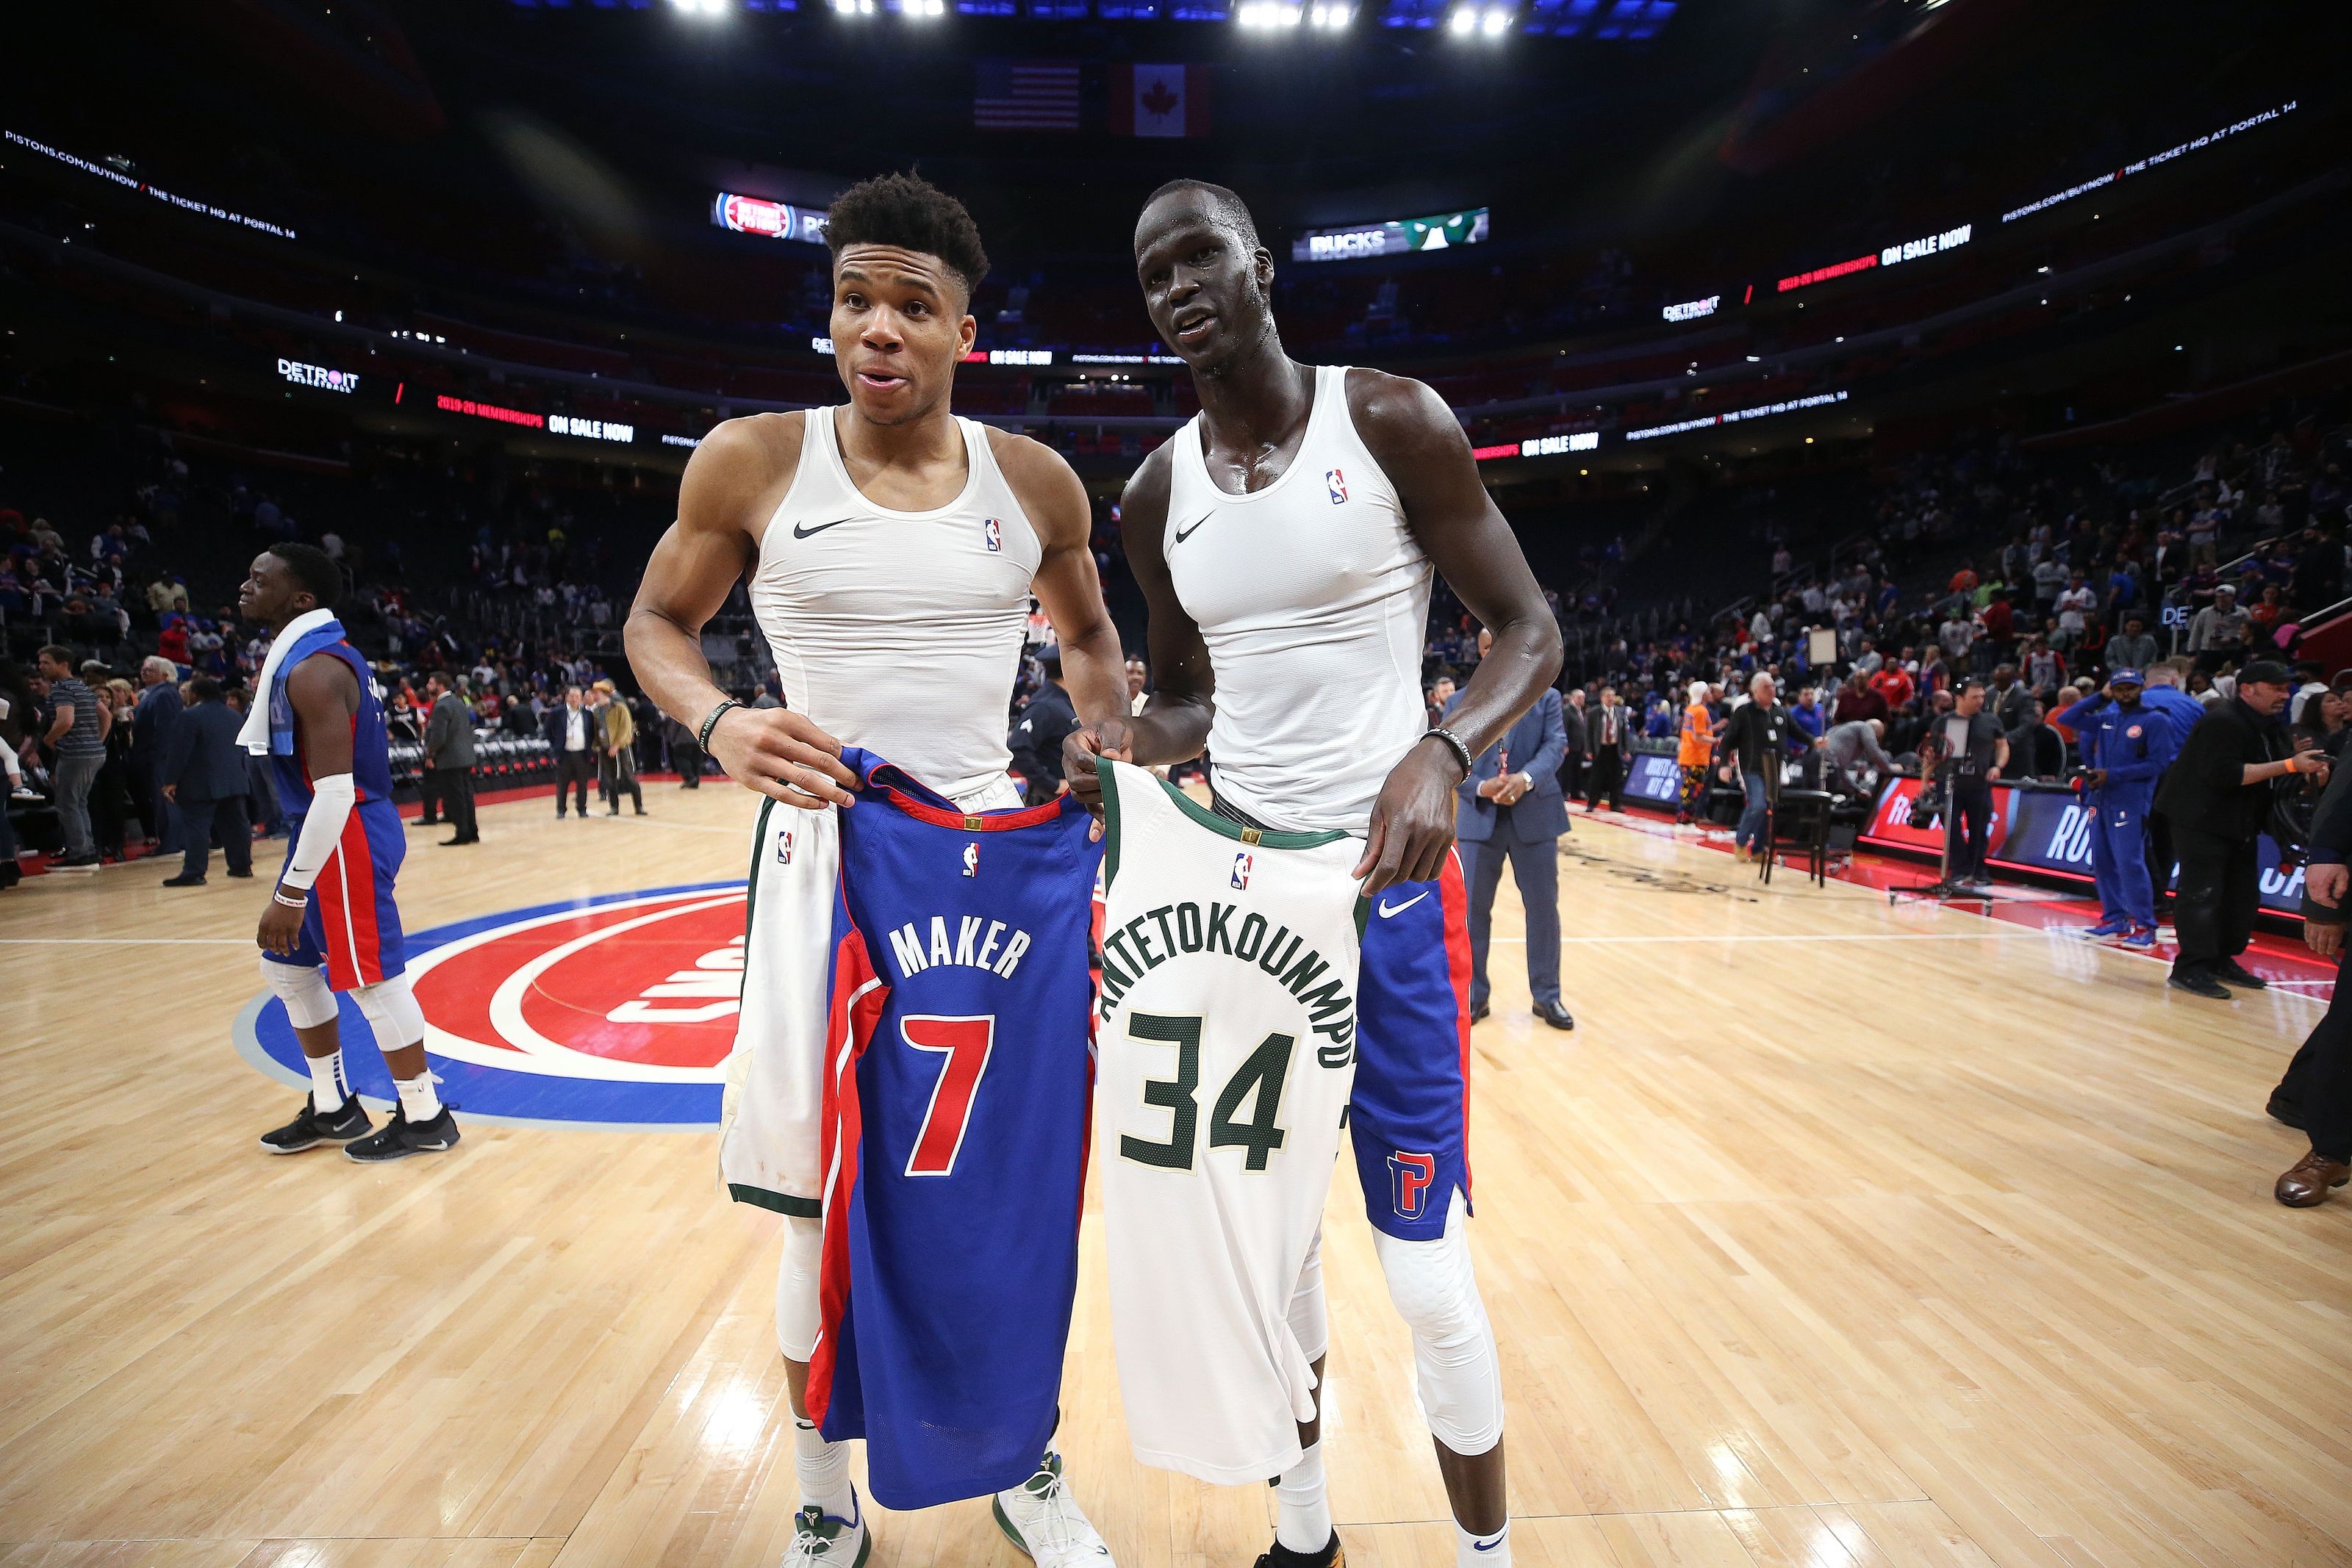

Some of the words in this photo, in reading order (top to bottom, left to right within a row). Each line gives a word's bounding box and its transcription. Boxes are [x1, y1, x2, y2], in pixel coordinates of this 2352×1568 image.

[2124, 161, 2146, 176] THE
[2148, 144, 2188, 166] TICKET
[2190, 136, 2208, 150] HQ
[2210, 128, 2227, 142] AT
[2229, 109, 2279, 134] PORTAL
[2282, 101, 2297, 113] 14
[148, 186, 168, 202] THE
[171, 194, 207, 214] TICKET
[210, 206, 226, 219] HQ
[229, 212, 242, 223] AT
[244, 217, 284, 237] PORTAL
[285, 229, 295, 239] 14
[1309, 230, 1385, 253] BUCKS
[1882, 245, 1901, 266] ON
[1903, 235, 1937, 260] SALE
[1938, 224, 1971, 251] NOW
[477, 403, 544, 428] MEMBERSHIPS
[548, 414, 568, 434] ON
[570, 417, 602, 439] SALE
[603, 422, 634, 443] NOW
[1522, 439, 1540, 457] ON
[1540, 435, 1569, 455] SALE
[1569, 432, 1599, 451] NOW
[888, 915, 1031, 980] MAKER
[900, 1014, 995, 1177] 7
[1117, 1007, 1301, 1176] 34
